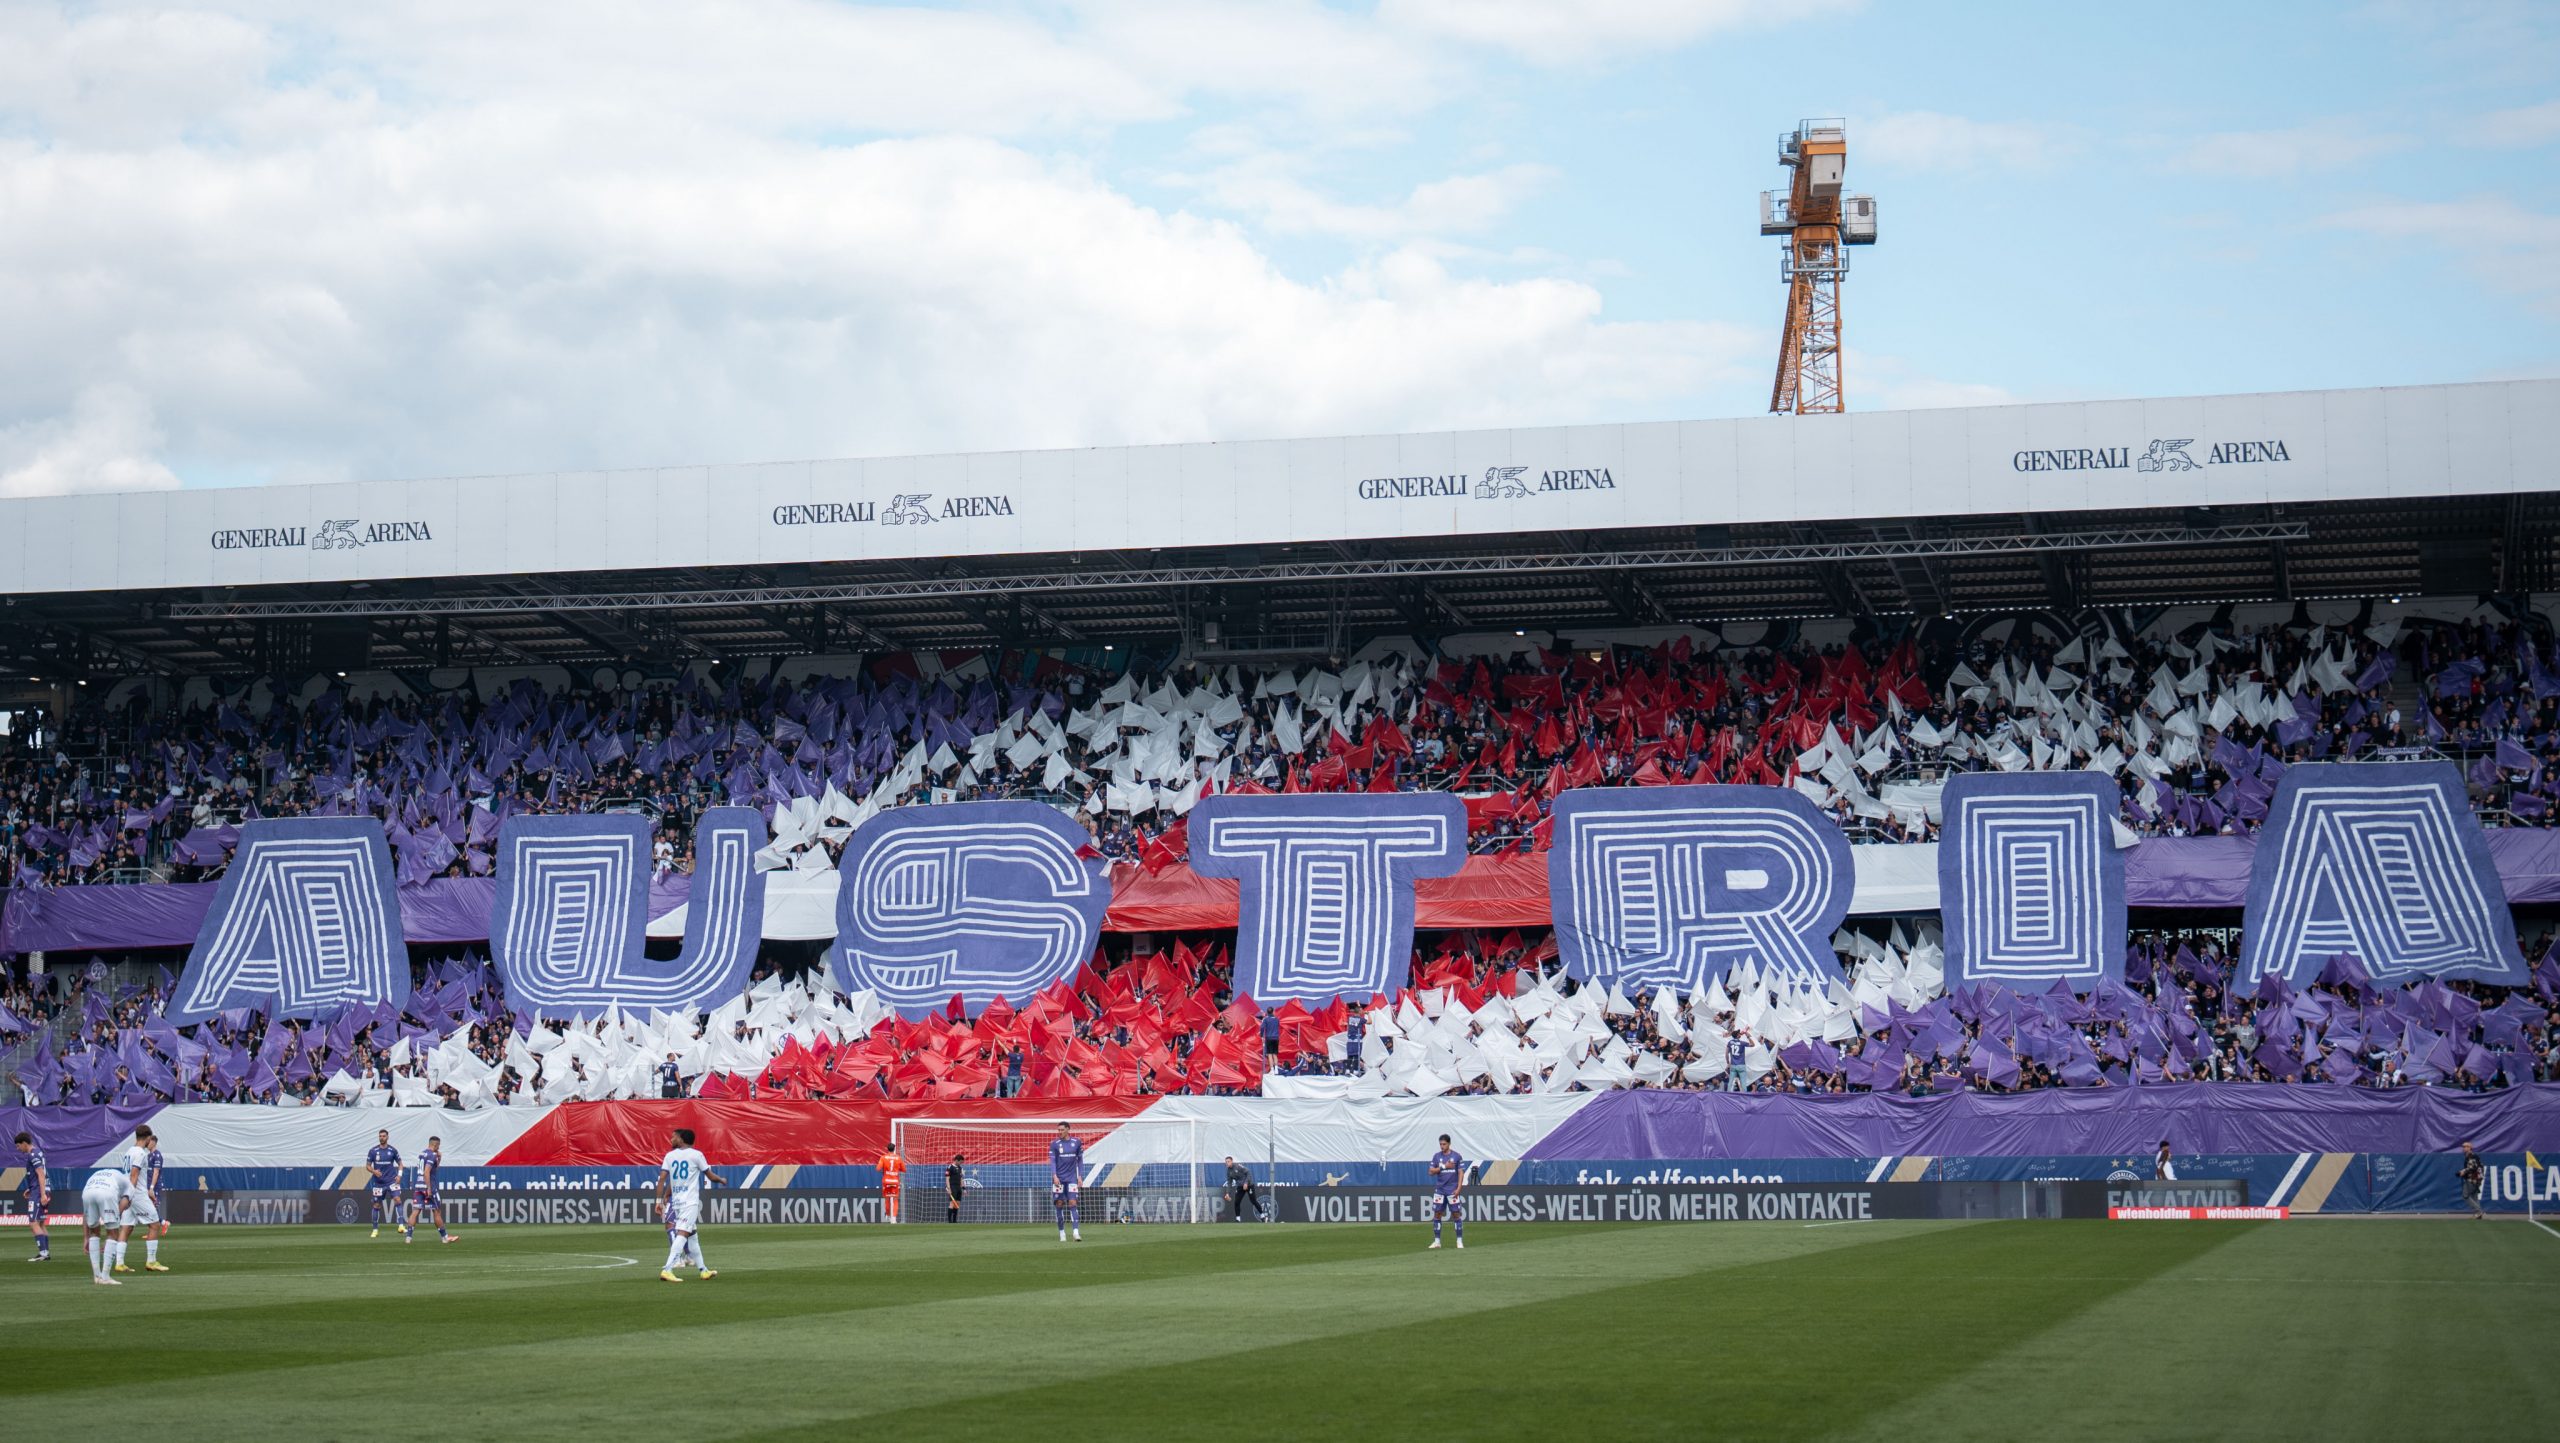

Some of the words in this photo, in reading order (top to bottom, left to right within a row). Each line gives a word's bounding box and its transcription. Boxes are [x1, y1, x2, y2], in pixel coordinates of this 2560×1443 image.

[2013, 447, 2130, 472] GENERALI
[2208, 439, 2291, 464] ARENA
[1358, 474, 1468, 500] GENERALI
[1537, 468, 1616, 492] ARENA
[773, 501, 876, 526] GENERALI
[940, 495, 1014, 519] ARENA
[211, 526, 307, 550] GENERALI
[364, 520, 433, 543] ARENA
[175, 765, 2520, 1022] AUSTRIA
[671, 1159, 689, 1180] 28
[203, 1198, 311, 1224] FAK.AT/VIP
[382, 1198, 480, 1224] VOLTTE
[486, 1198, 653, 1224] BUSINESS-WELT
[711, 1197, 772, 1223] MEHR
[1304, 1195, 1412, 1222] VIOLETTE
[1420, 1194, 1607, 1222] BSINESS-WELT
[1615, 1189, 1662, 1221] FÜR
[1669, 1193, 1739, 1221] MEHR
[1747, 1192, 1872, 1220] KONTAKTE
[2107, 1189, 2241, 1207] FAKAT/VIP
[2117, 1207, 2191, 1220] wienholding
[2206, 1207, 2281, 1219] wienholding
